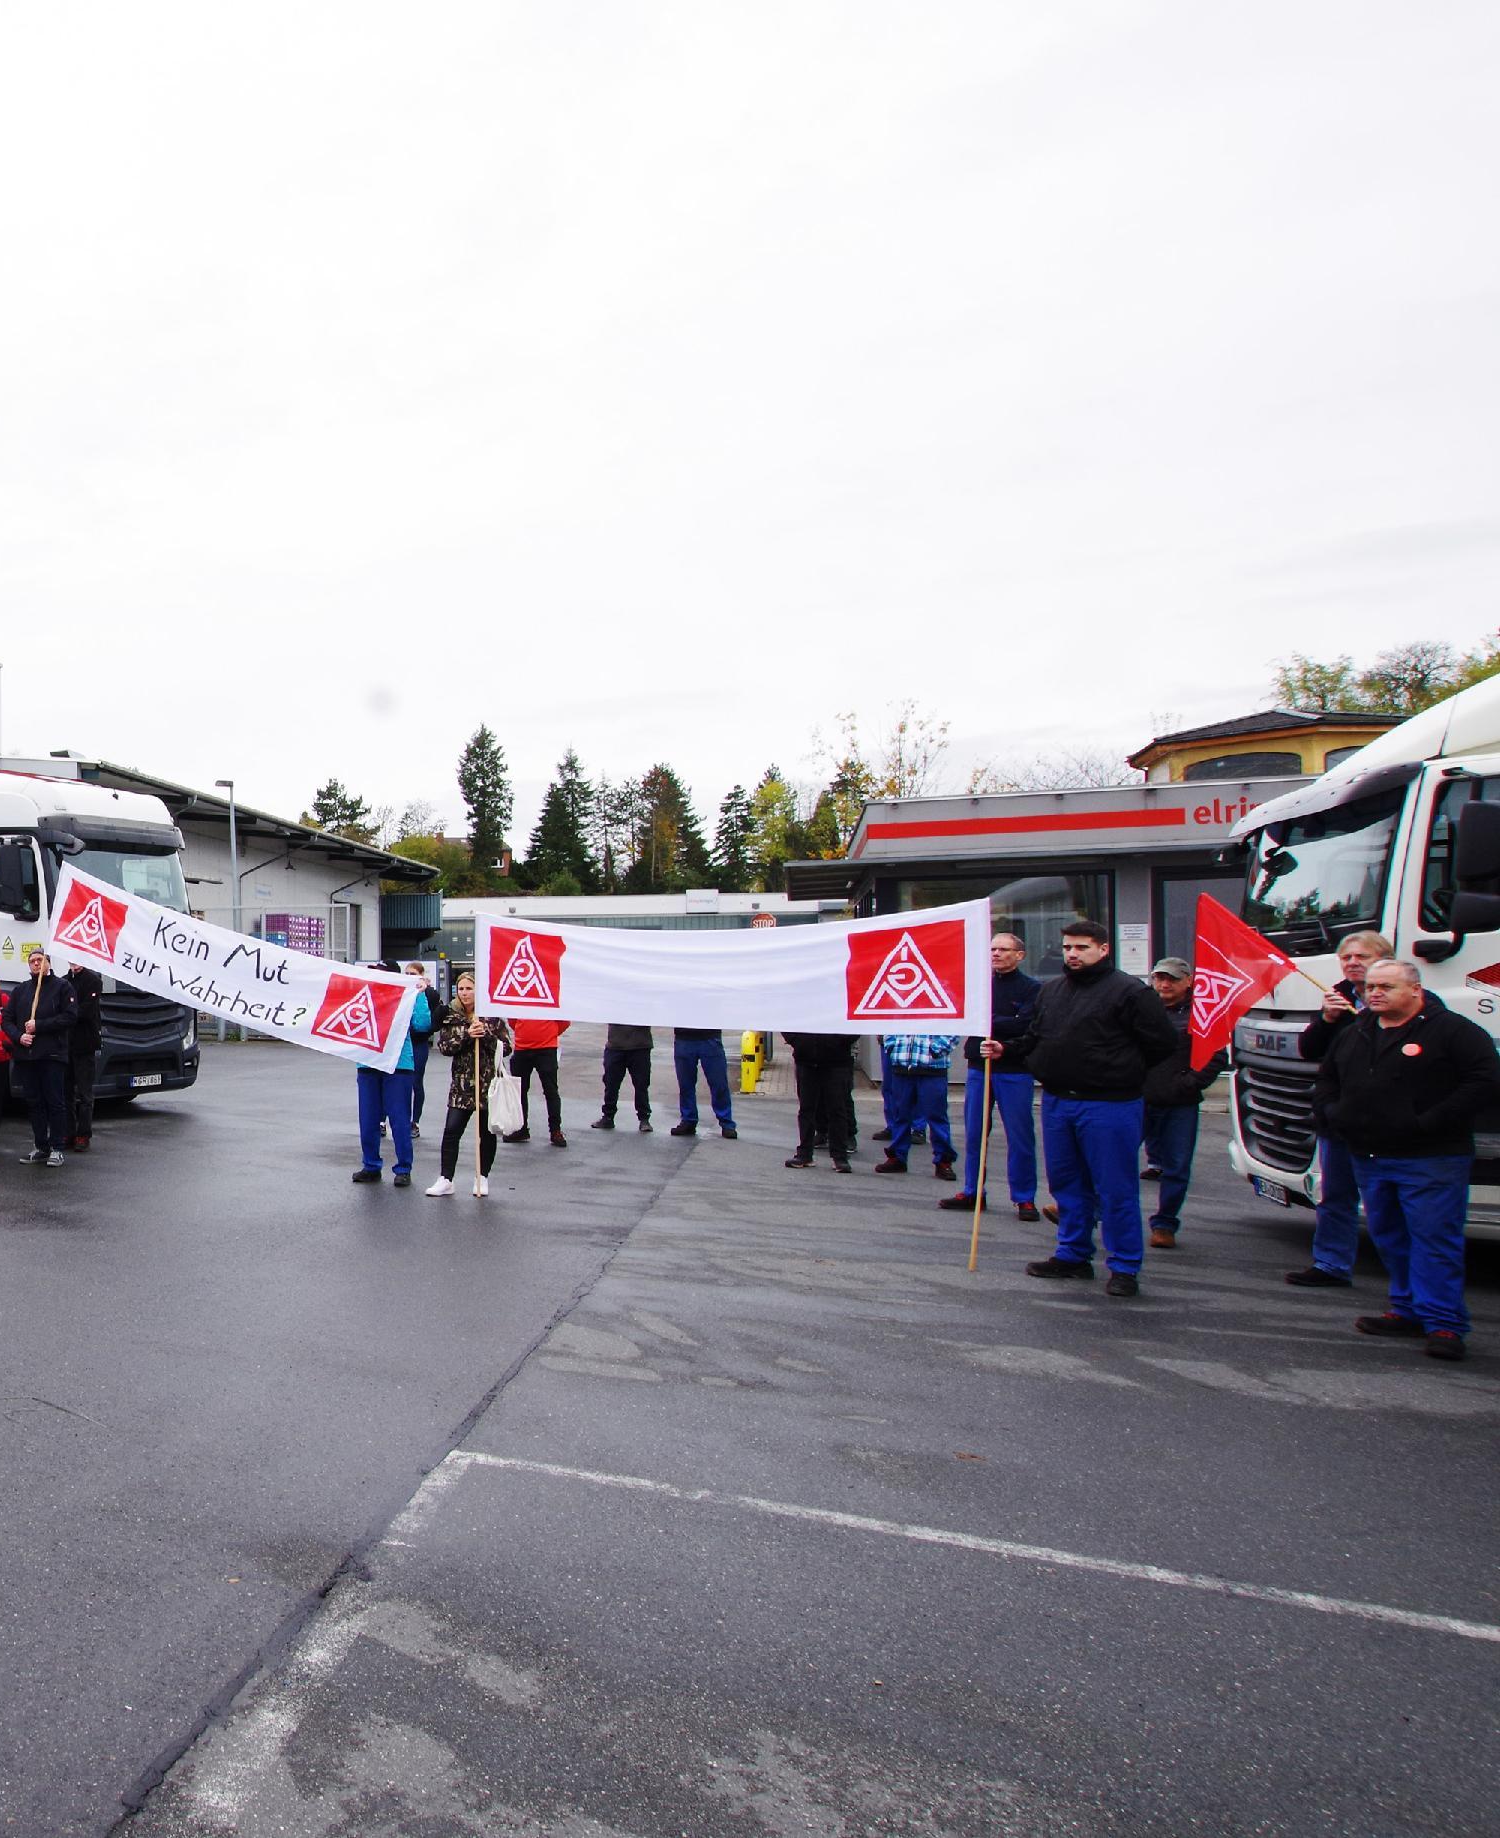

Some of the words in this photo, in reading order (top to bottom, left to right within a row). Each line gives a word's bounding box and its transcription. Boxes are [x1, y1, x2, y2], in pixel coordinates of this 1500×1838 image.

[752, 919, 774, 928] STOP
[153, 916, 209, 960] Kein
[223, 943, 289, 985] Mut
[121, 951, 160, 976] zur
[1255, 1033, 1287, 1052] DAF
